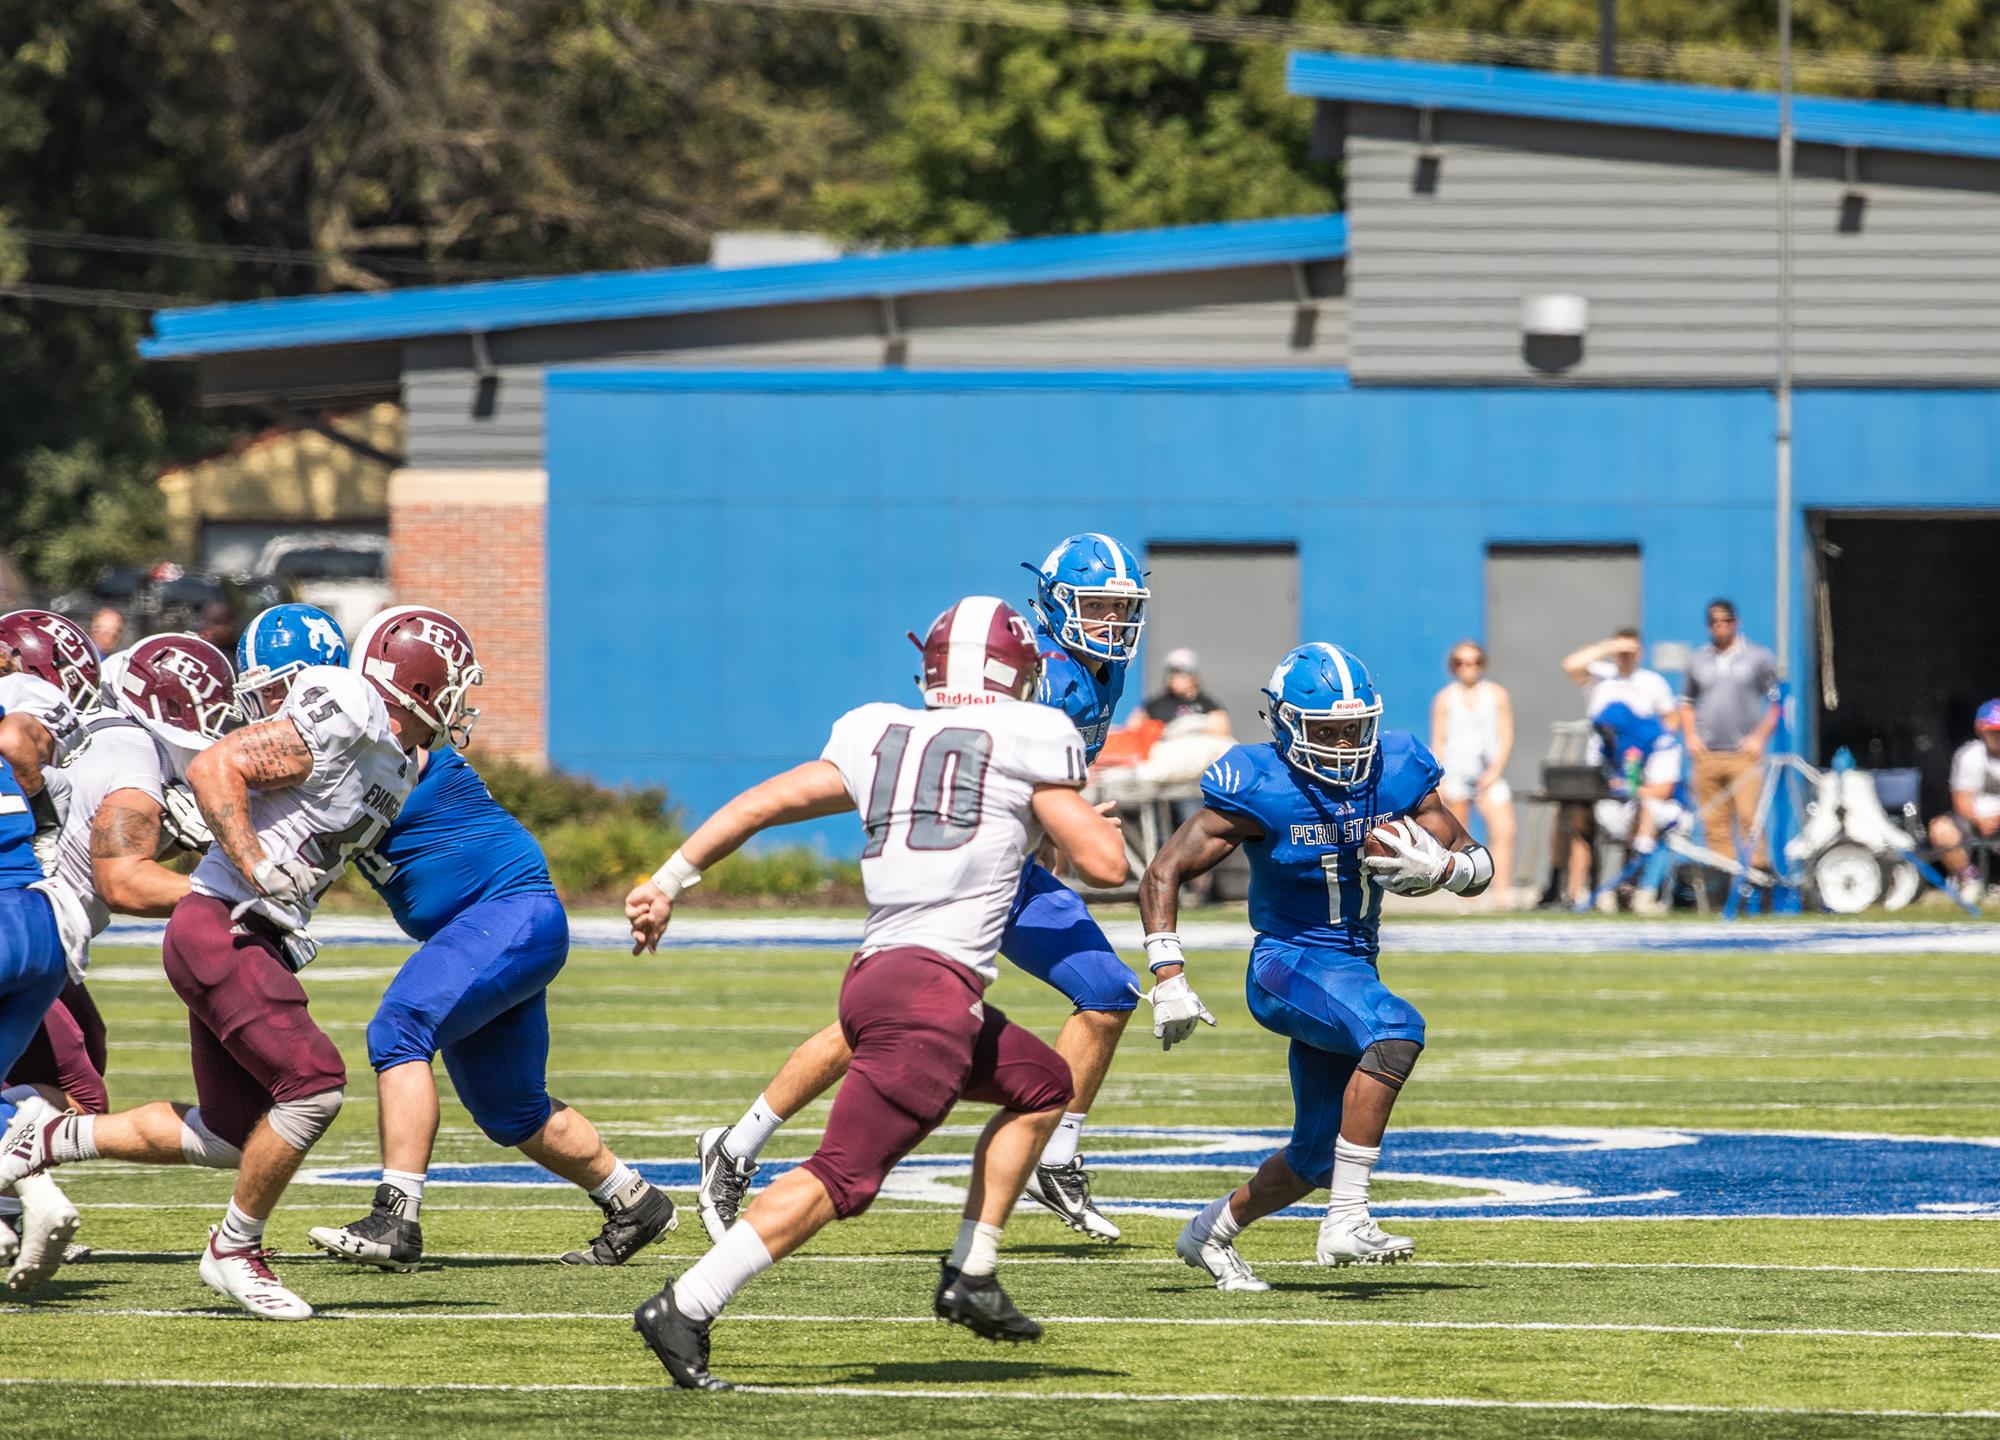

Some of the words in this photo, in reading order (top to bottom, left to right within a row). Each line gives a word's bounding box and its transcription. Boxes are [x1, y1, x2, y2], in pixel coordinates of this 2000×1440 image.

[299, 686, 343, 723] 45
[936, 691, 996, 705] Riddell
[862, 723, 993, 859] 10
[1290, 823, 1338, 845] PERU
[1321, 847, 1371, 925] 11
